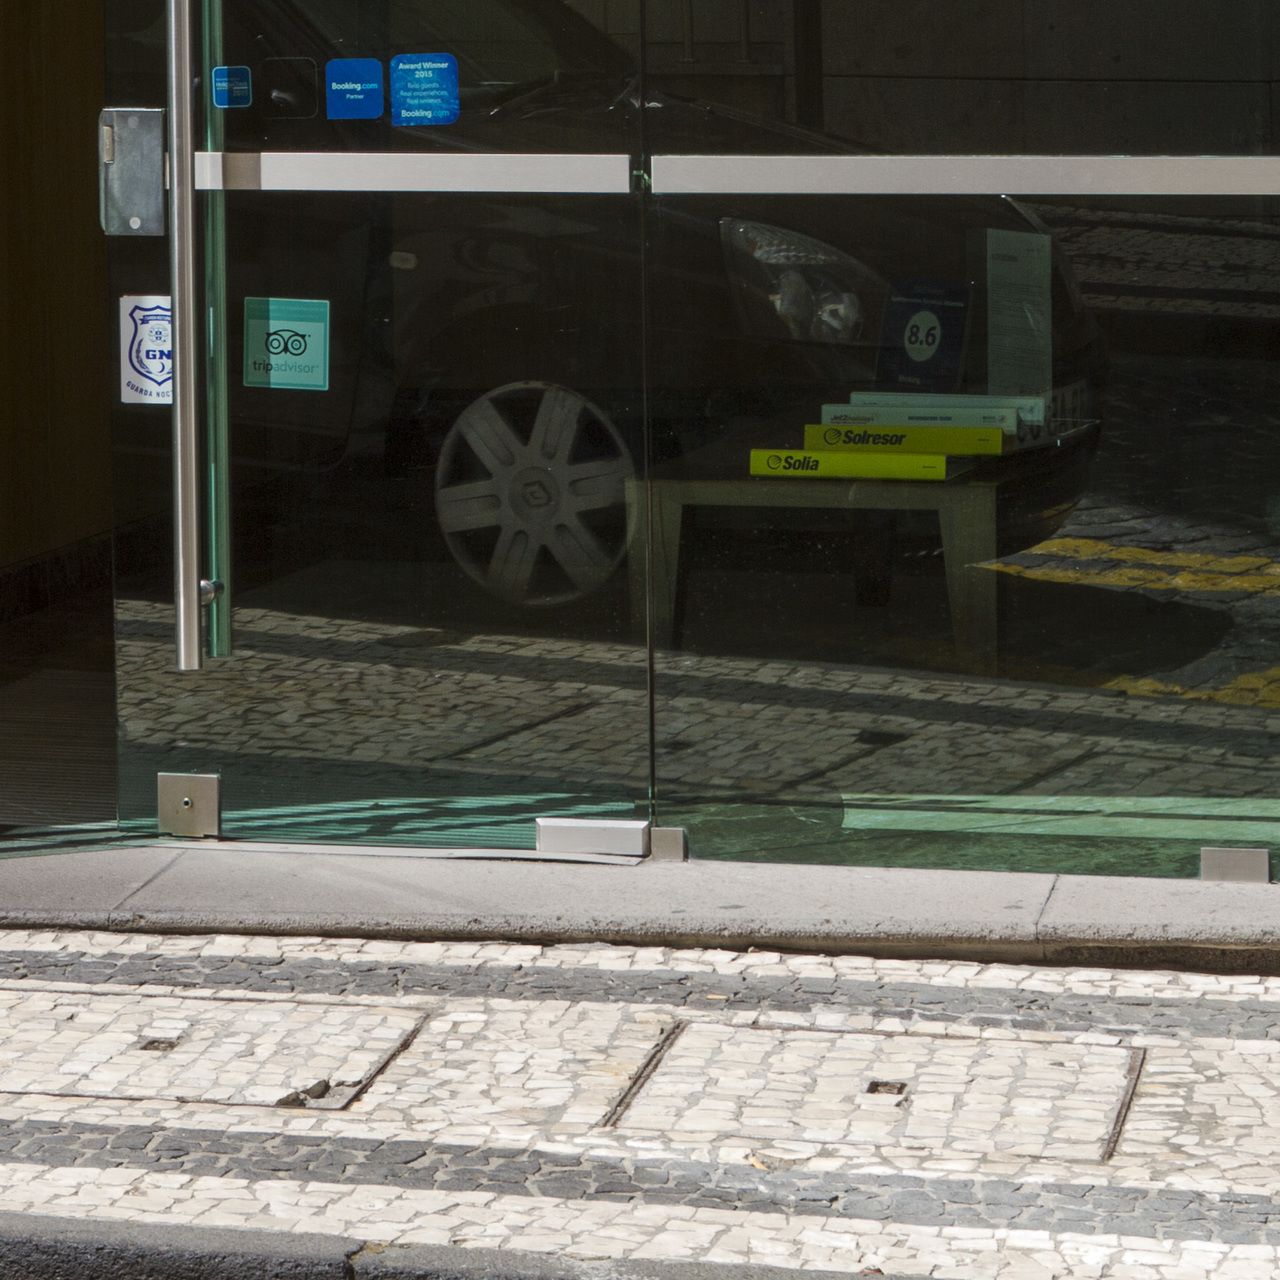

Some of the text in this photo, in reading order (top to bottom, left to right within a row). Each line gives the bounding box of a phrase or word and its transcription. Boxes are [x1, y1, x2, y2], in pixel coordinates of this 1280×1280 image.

[398, 61, 449, 70] Award Winner
[414, 70, 433, 78] 2015
[331, 81, 378, 91] Booking.com
[401, 109, 450, 119] Booking.com
[907, 324, 937, 347] 8.6
[253, 360, 315, 374] tripadvisor
[126, 380, 153, 398] GUARDA
[842, 429, 907, 447] Solresor
[782, 455, 819, 472] Solia
